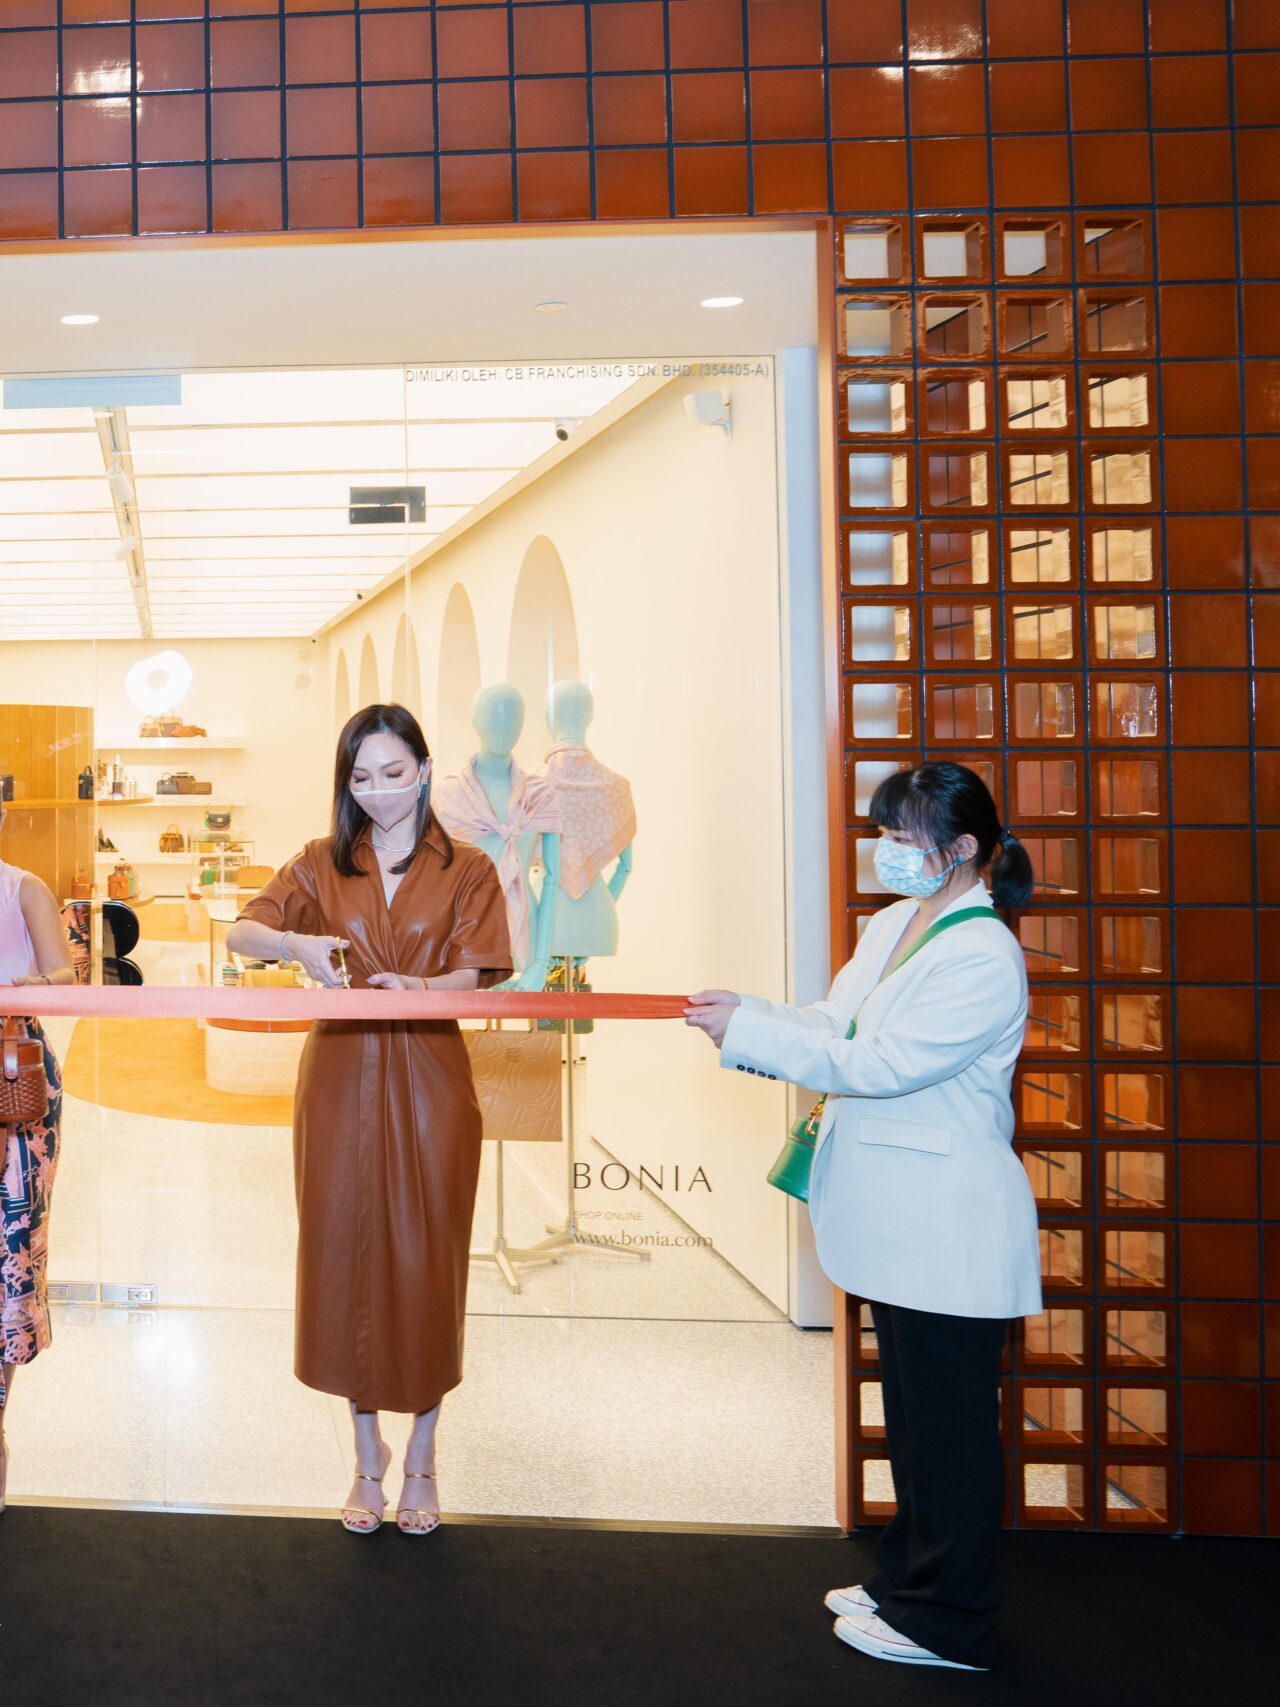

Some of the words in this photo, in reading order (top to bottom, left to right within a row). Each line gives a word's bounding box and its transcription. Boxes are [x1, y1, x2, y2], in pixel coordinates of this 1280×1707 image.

[406, 369, 458, 382] DIMILIKI
[461, 369, 501, 382] OLEH:
[505, 367, 523, 380] CB
[528, 365, 623, 380] FRANCHISING
[628, 364, 660, 378] SDN.
[662, 364, 694, 377] BHD.
[699, 362, 769, 378] (354405-A)
[573, 1162, 713, 1192] BONIA
[573, 1210, 602, 1220] SHOP
[605, 1211, 644, 1221] ONLINE
[574, 1229, 713, 1248] www.bonia.com
